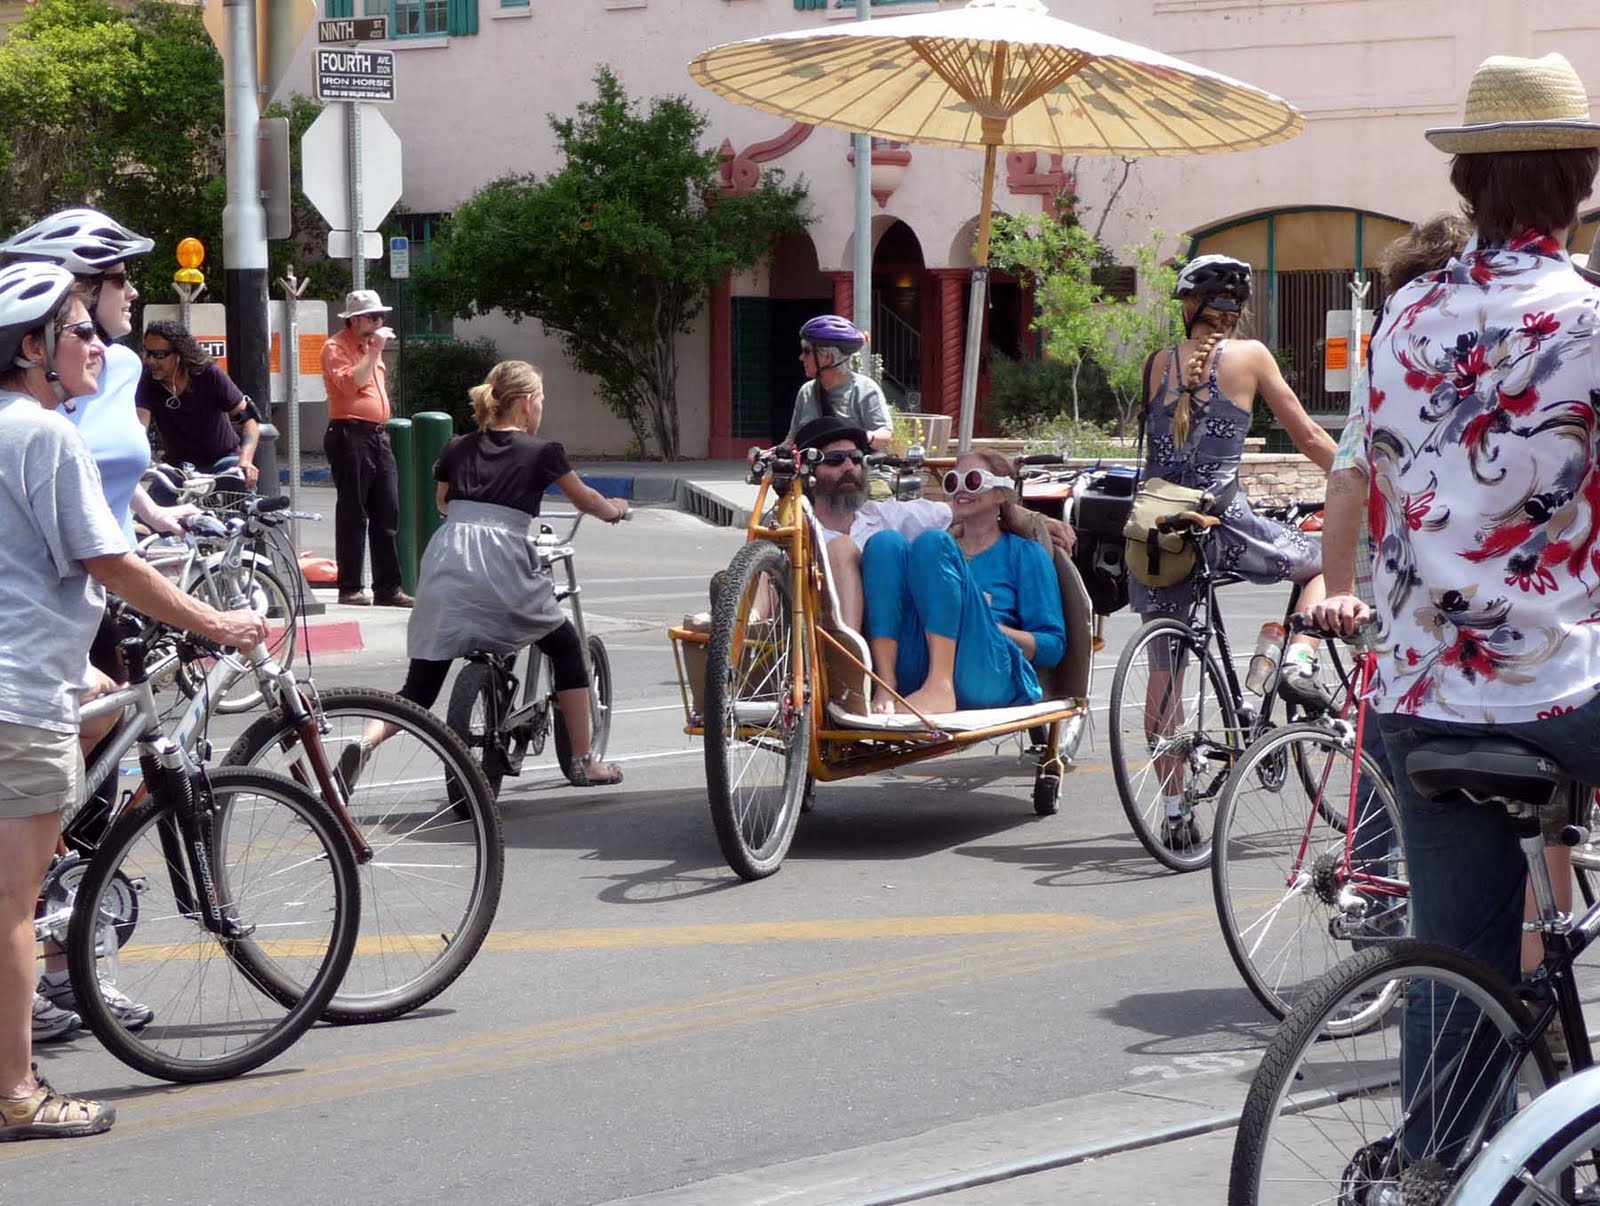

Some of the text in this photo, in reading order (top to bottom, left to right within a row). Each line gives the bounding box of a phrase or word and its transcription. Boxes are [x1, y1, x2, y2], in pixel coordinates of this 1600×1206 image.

[320, 21, 355, 40] NINTH
[320, 52, 371, 73] FOURTH
[322, 77, 391, 87] IRON HORSE
